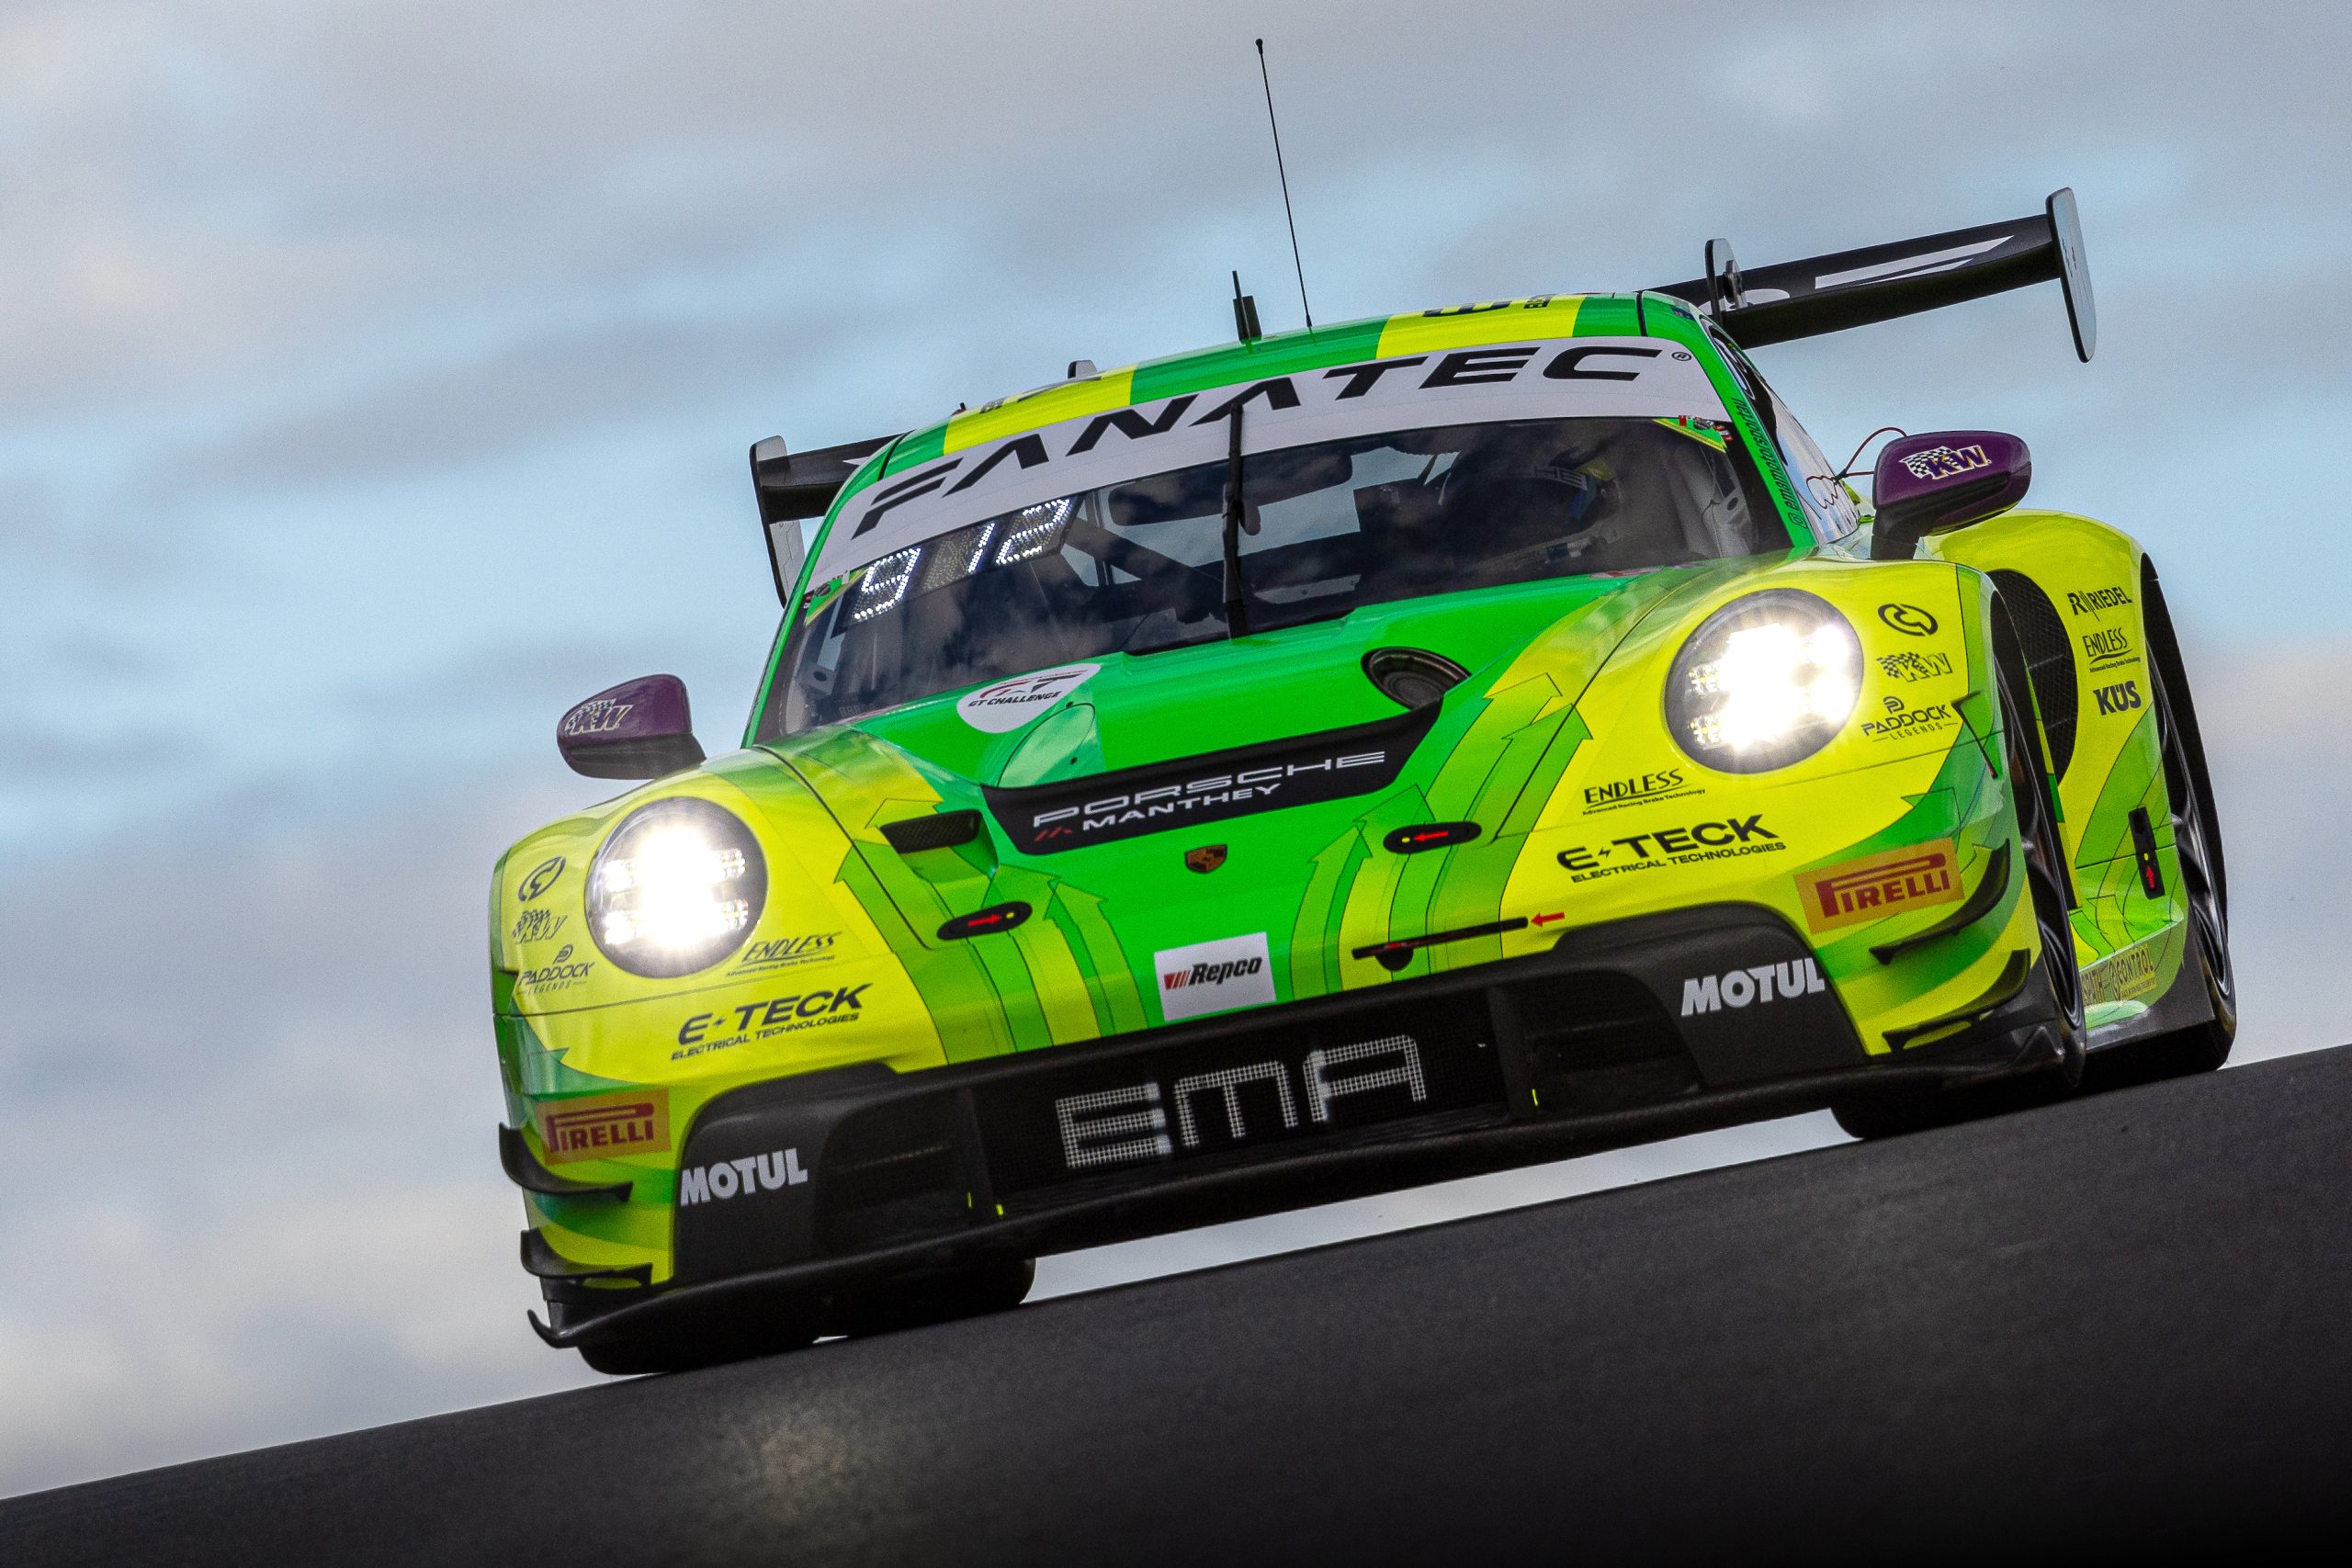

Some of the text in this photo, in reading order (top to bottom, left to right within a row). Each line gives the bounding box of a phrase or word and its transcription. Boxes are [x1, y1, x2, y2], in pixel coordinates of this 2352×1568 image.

[1924, 445, 1990, 479] KW
[854, 498, 1070, 621] 912
[2086, 587, 2132, 611] RIEDEL
[2082, 627, 2128, 658] ENDLESS
[968, 699, 989, 707] GT
[2093, 681, 2142, 716] KÜS
[1860, 705, 1951, 737] PADDOCK
[1889, 722, 1944, 741] LEGENDS
[1034, 750, 1386, 828] PORSCHE
[1082, 783, 1282, 830] MANTHEY
[1584, 768, 1684, 806] ENDLESS
[1571, 842, 1787, 884] ELECTRICAL TECHNOLOGIES
[1815, 852, 1951, 919] PIRELLI
[519, 962, 595, 987] PADDOCK
[1189, 956, 1263, 987] Repco
[1681, 957, 1826, 1017] MOTUL
[671, 1012, 860, 1062] ELECTRICAL TECHNOLOGIES
[1056, 1034, 1428, 1169] EMA
[546, 1101, 655, 1153] PIRELLI
[681, 1147, 808, 1207] MOTUL
